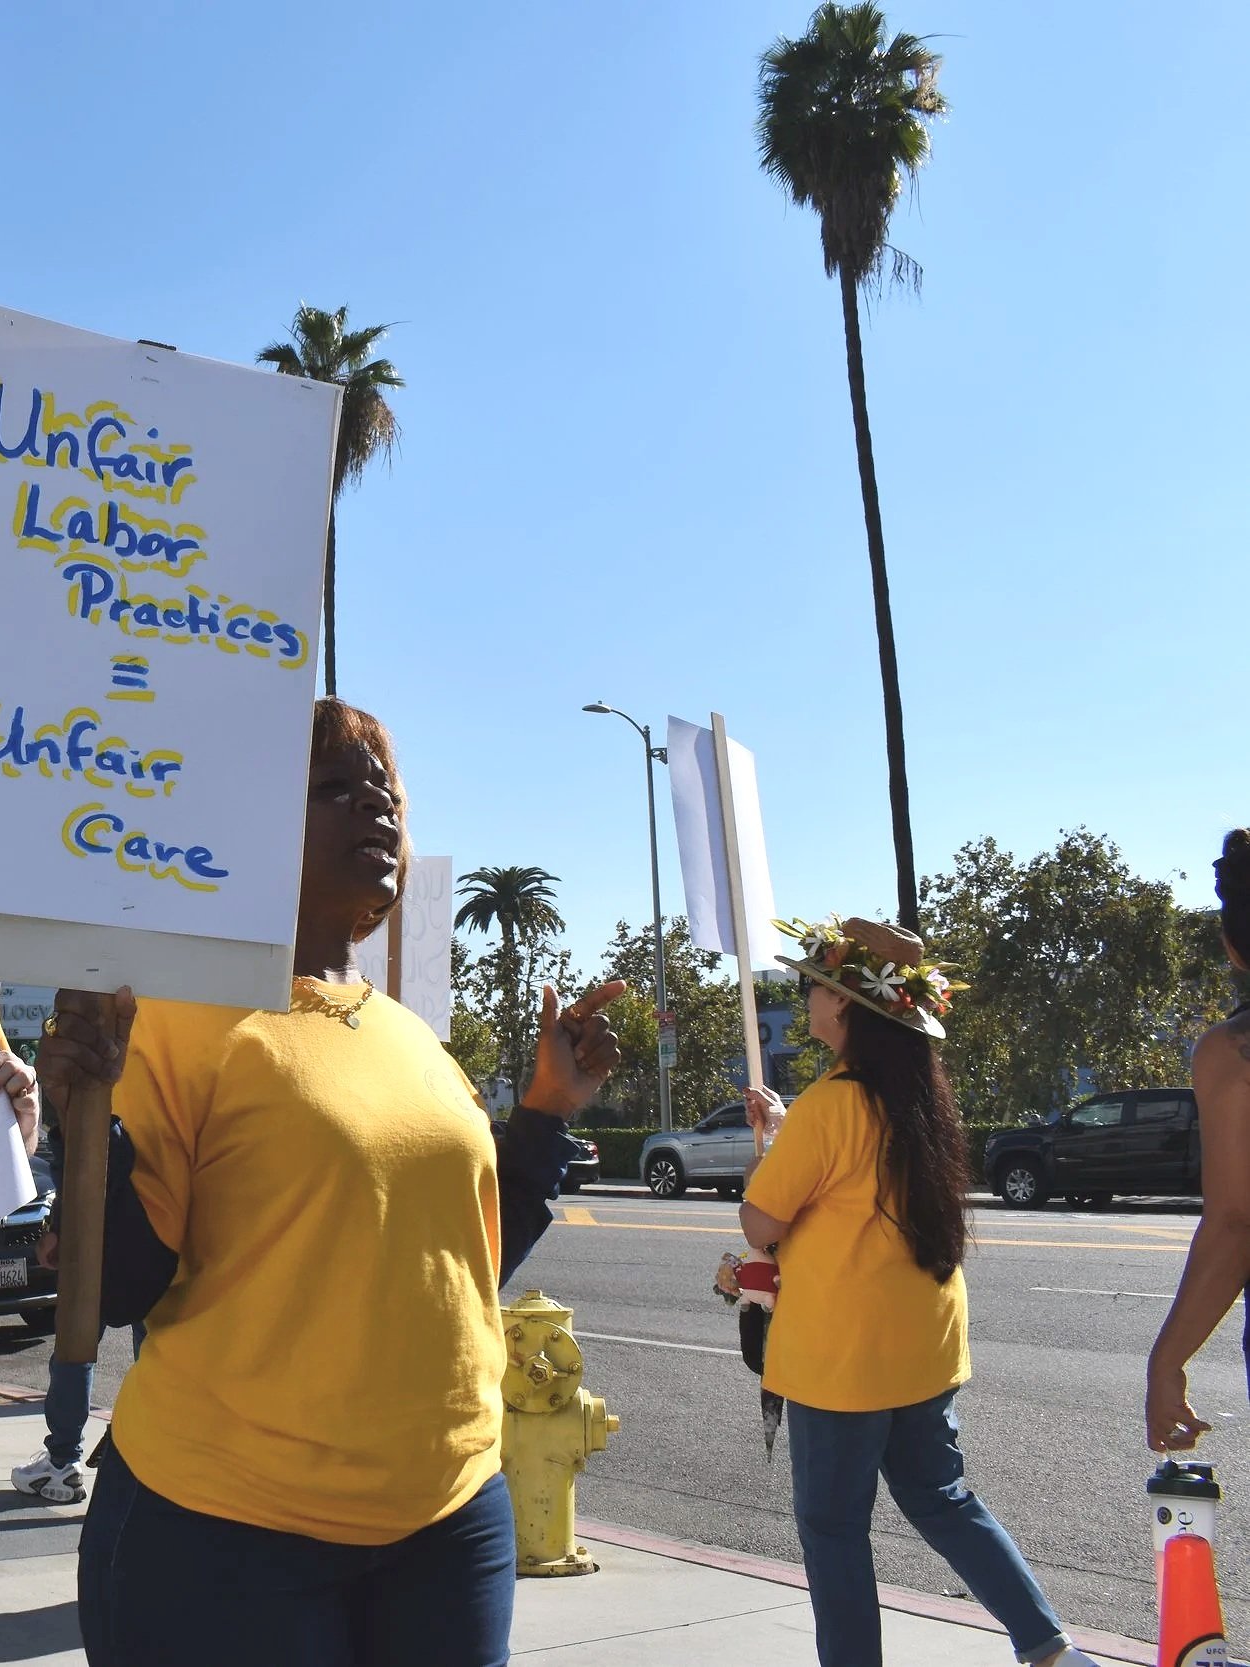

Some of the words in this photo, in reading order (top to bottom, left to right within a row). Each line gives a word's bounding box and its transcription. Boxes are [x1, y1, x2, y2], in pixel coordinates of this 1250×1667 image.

[13, 481, 208, 578] Labor
[54, 552, 309, 670] Practices
[62, 802, 229, 892] Care
